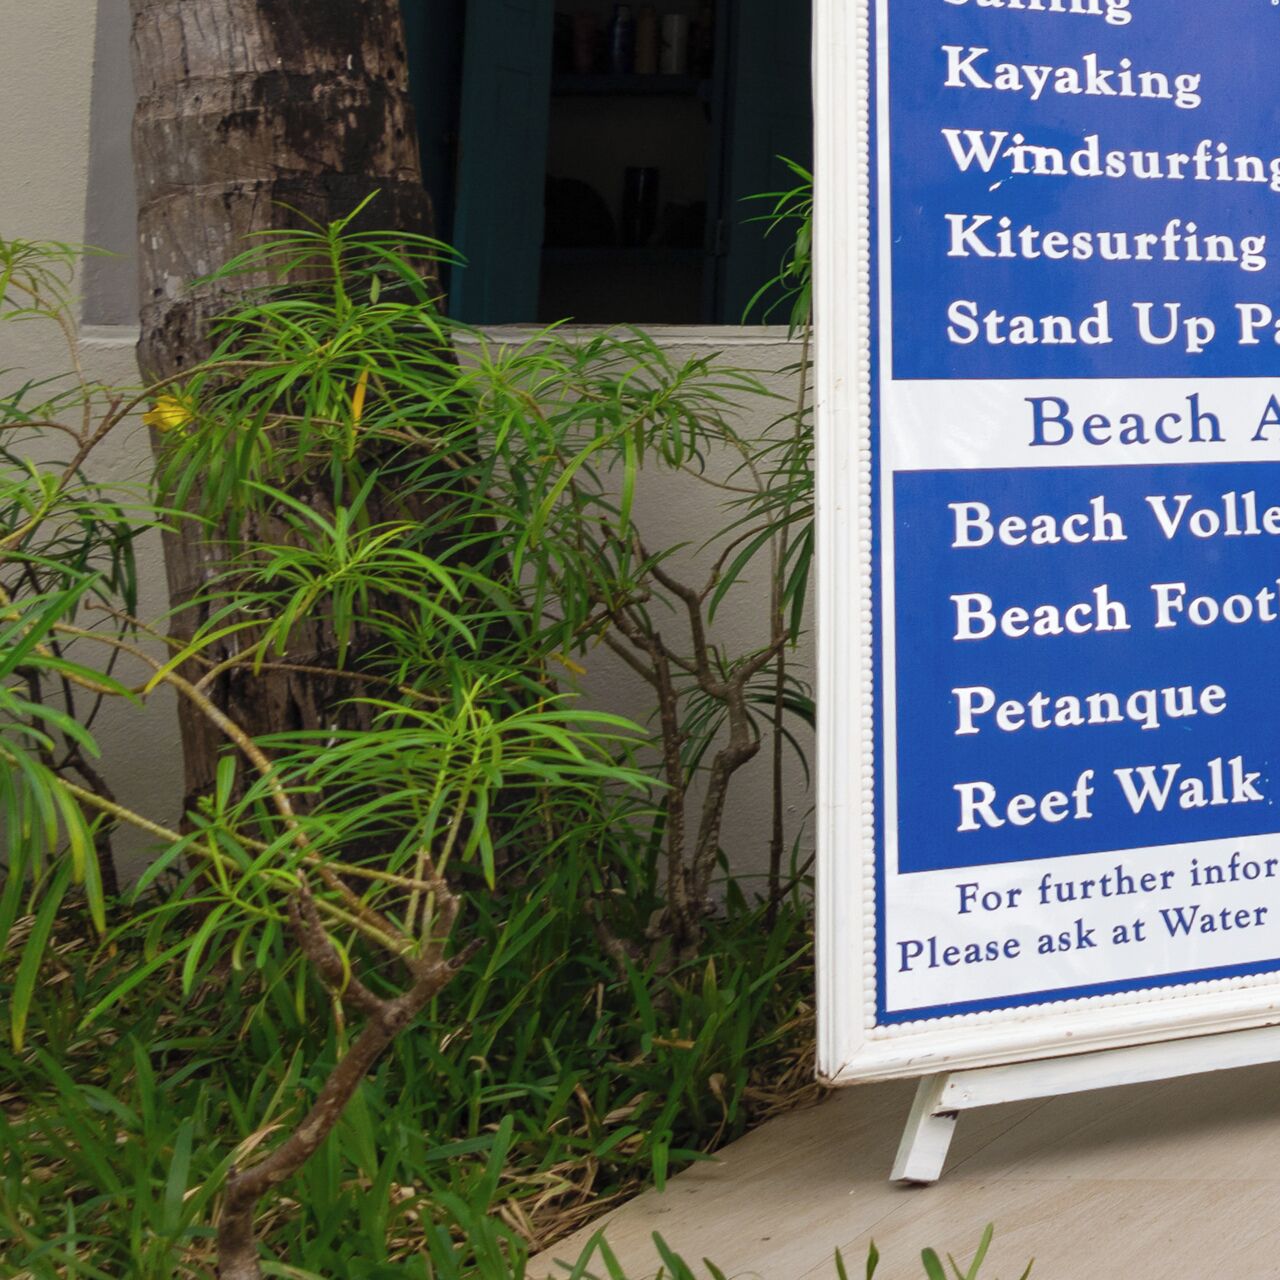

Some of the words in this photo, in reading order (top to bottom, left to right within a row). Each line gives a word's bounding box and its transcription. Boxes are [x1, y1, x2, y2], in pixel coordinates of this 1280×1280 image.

[942, 46, 1201, 108] Kayaking
[945, 214, 1266, 271] Kitesurfing
[947, 300, 1113, 344] Stand
[1132, 303, 1215, 352] Up
[1025, 393, 1225, 446] Beach
[948, 496, 1127, 547] Beach
[950, 584, 1131, 640] Beach
[952, 685, 1226, 735] Petanque
[953, 770, 1094, 831] Reef
[1114, 756, 1264, 813] Walk
[956, 883, 1022, 914] For
[1038, 865, 1174, 904] further
[897, 937, 1020, 972] Please
[1038, 919, 1096, 954] ask
[1113, 919, 1145, 944] at
[1159, 905, 1267, 937] Water
